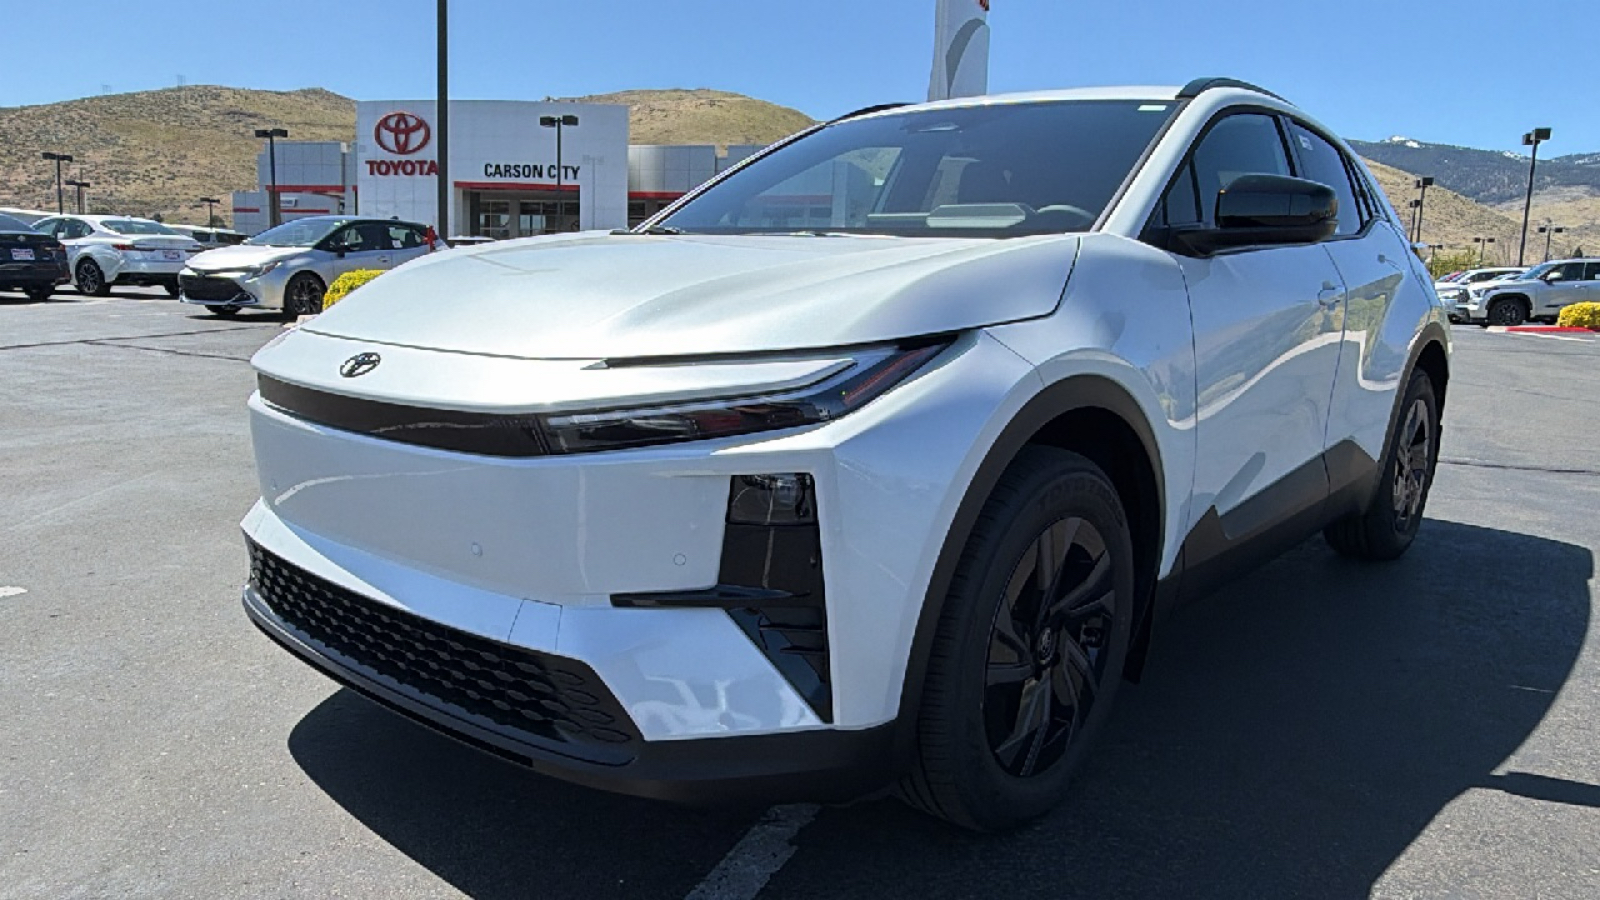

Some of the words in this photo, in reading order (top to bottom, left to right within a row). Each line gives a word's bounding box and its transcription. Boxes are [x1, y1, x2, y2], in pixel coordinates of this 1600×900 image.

[365, 160, 438, 176] TOYOTA
[484, 163, 543, 178] CARSON
[548, 165, 580, 180] CTY
